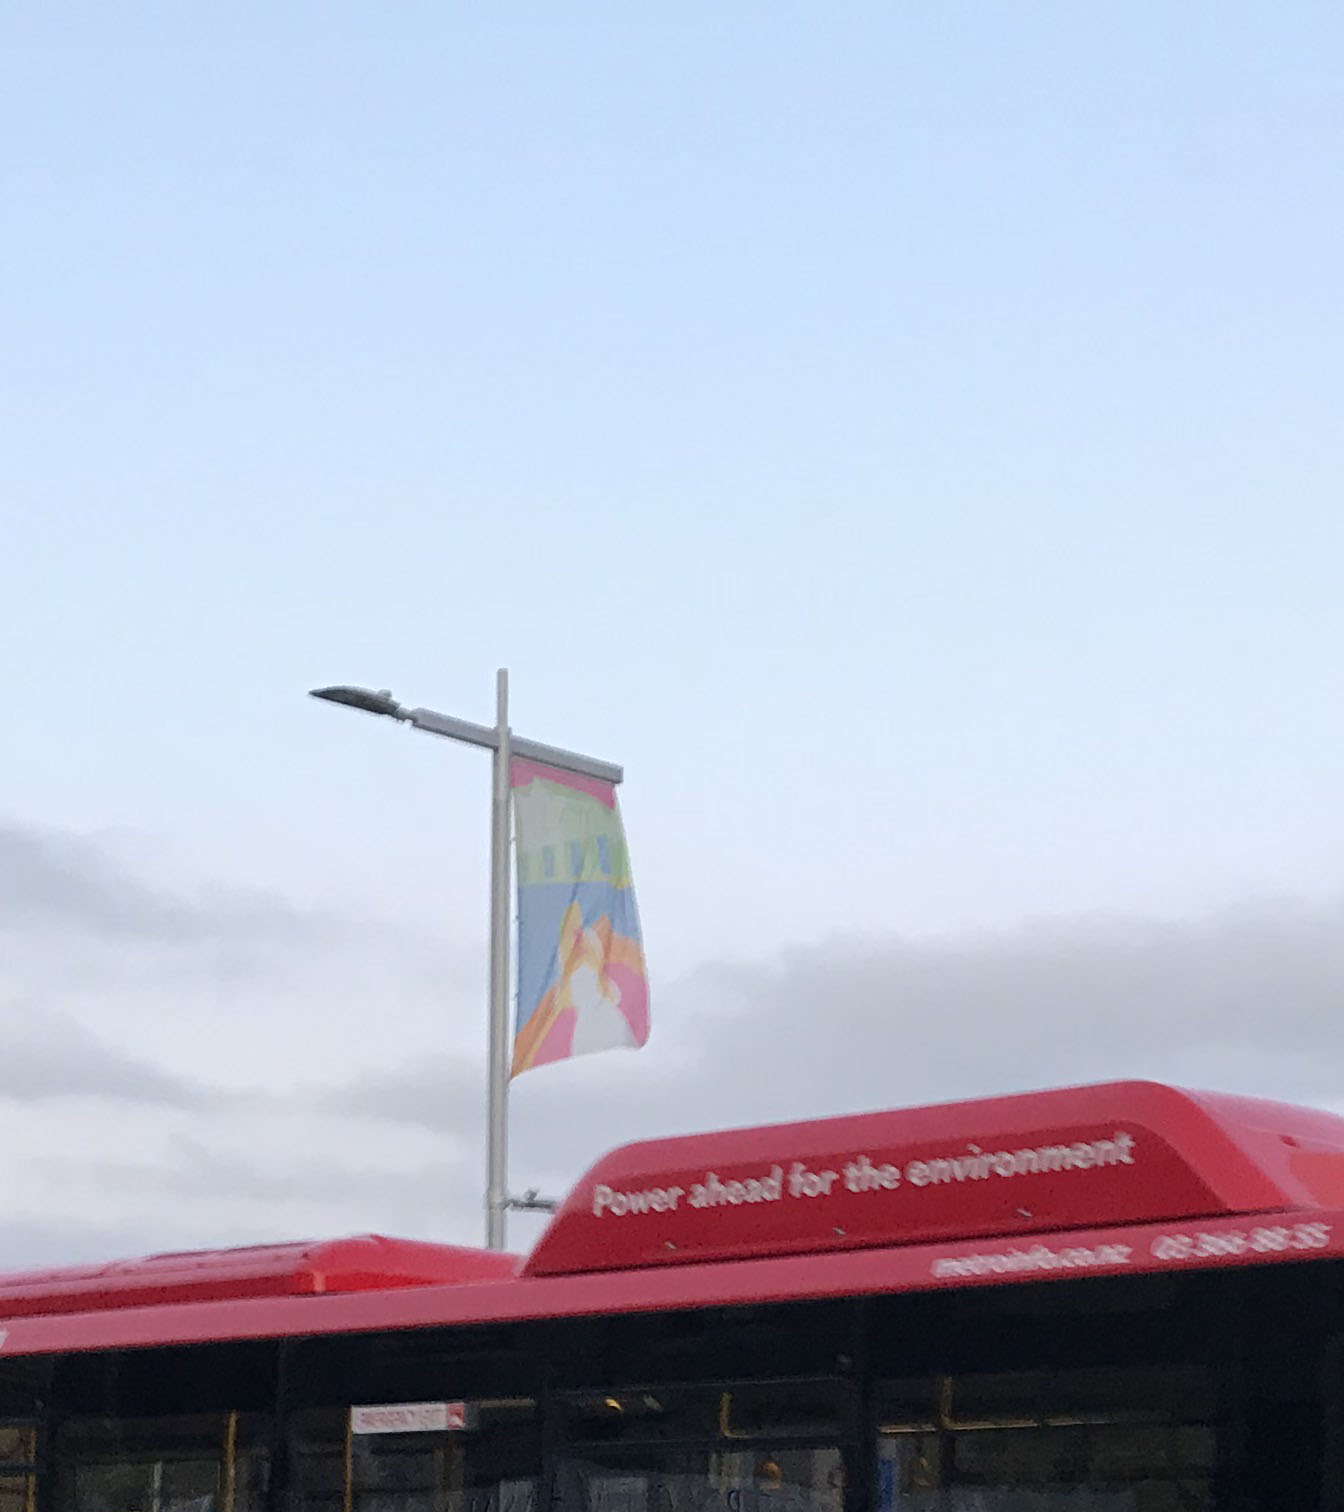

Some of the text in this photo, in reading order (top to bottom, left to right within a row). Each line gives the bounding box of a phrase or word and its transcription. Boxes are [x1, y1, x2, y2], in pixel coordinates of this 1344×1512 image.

[593, 1131, 1135, 1217] Power ahead for the environment
